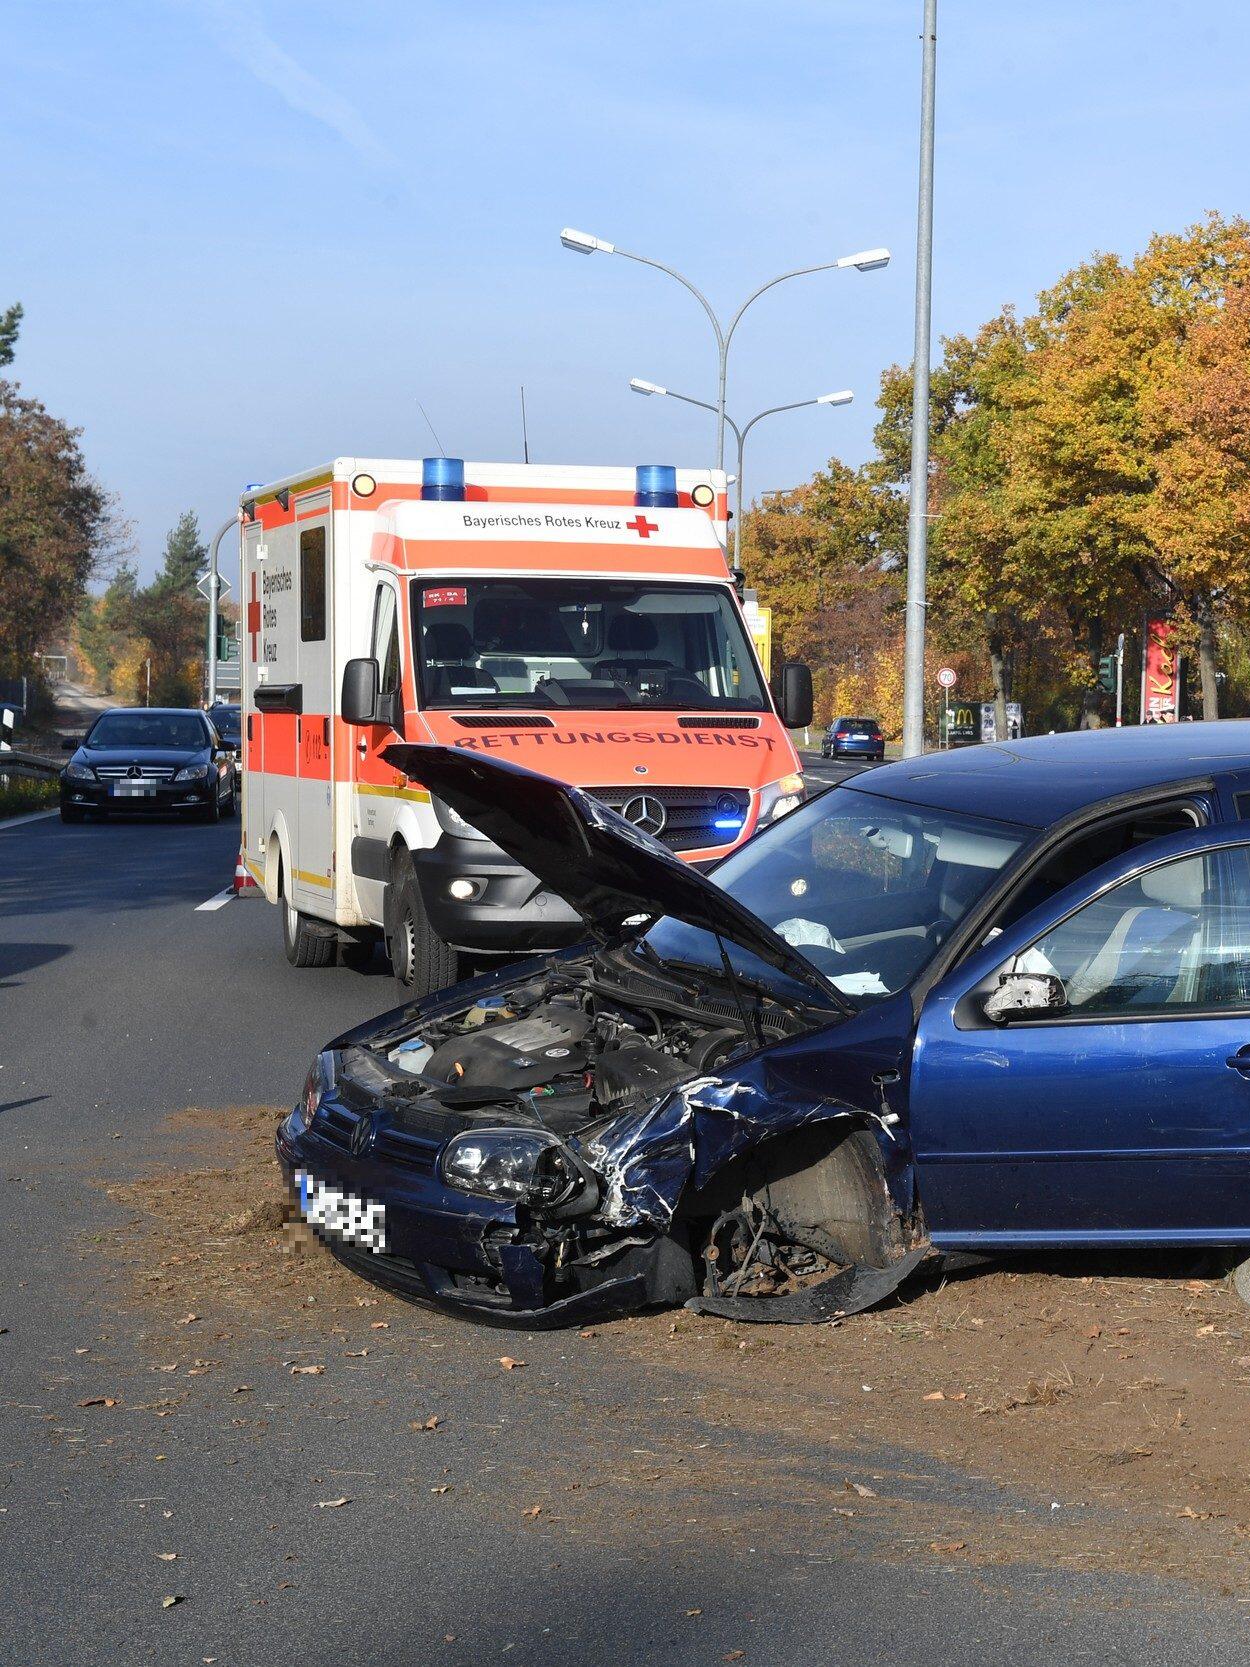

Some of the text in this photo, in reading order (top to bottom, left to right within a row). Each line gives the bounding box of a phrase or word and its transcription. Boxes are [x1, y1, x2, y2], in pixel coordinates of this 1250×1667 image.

[463, 514, 622, 530] Bayerisches Rotes Kreuz
[263, 566, 292, 600] Bayerisches
[263, 603, 277, 629] Rotes
[263, 638, 278, 662] Kreuz
[942, 673, 952, 681] 70
[453, 731, 777, 752] RETTUNGSDIENST
